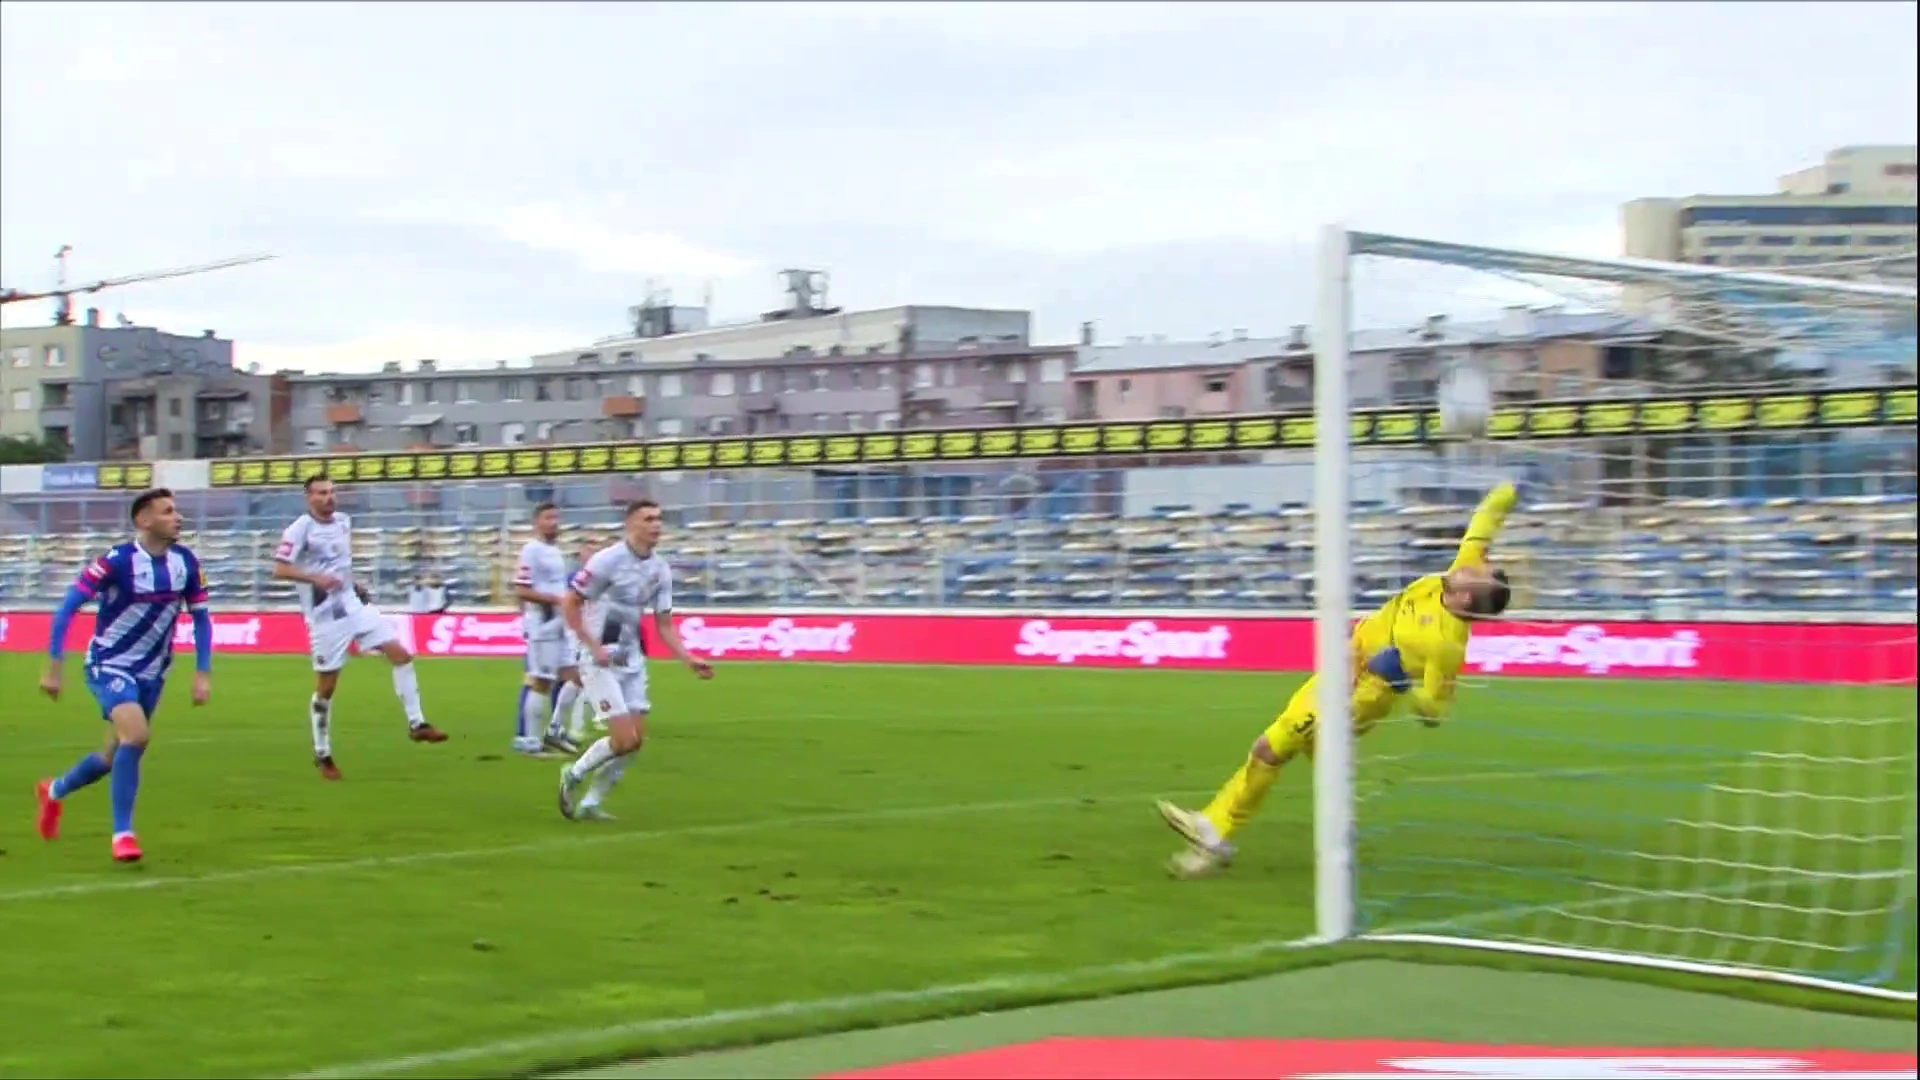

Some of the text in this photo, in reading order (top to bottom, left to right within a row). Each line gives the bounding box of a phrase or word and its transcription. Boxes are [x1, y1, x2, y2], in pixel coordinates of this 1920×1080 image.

[679, 616, 856, 658] SuperSport
[1013, 619, 1232, 664] SuperSport
[1465, 624, 1704, 674] uperSport
